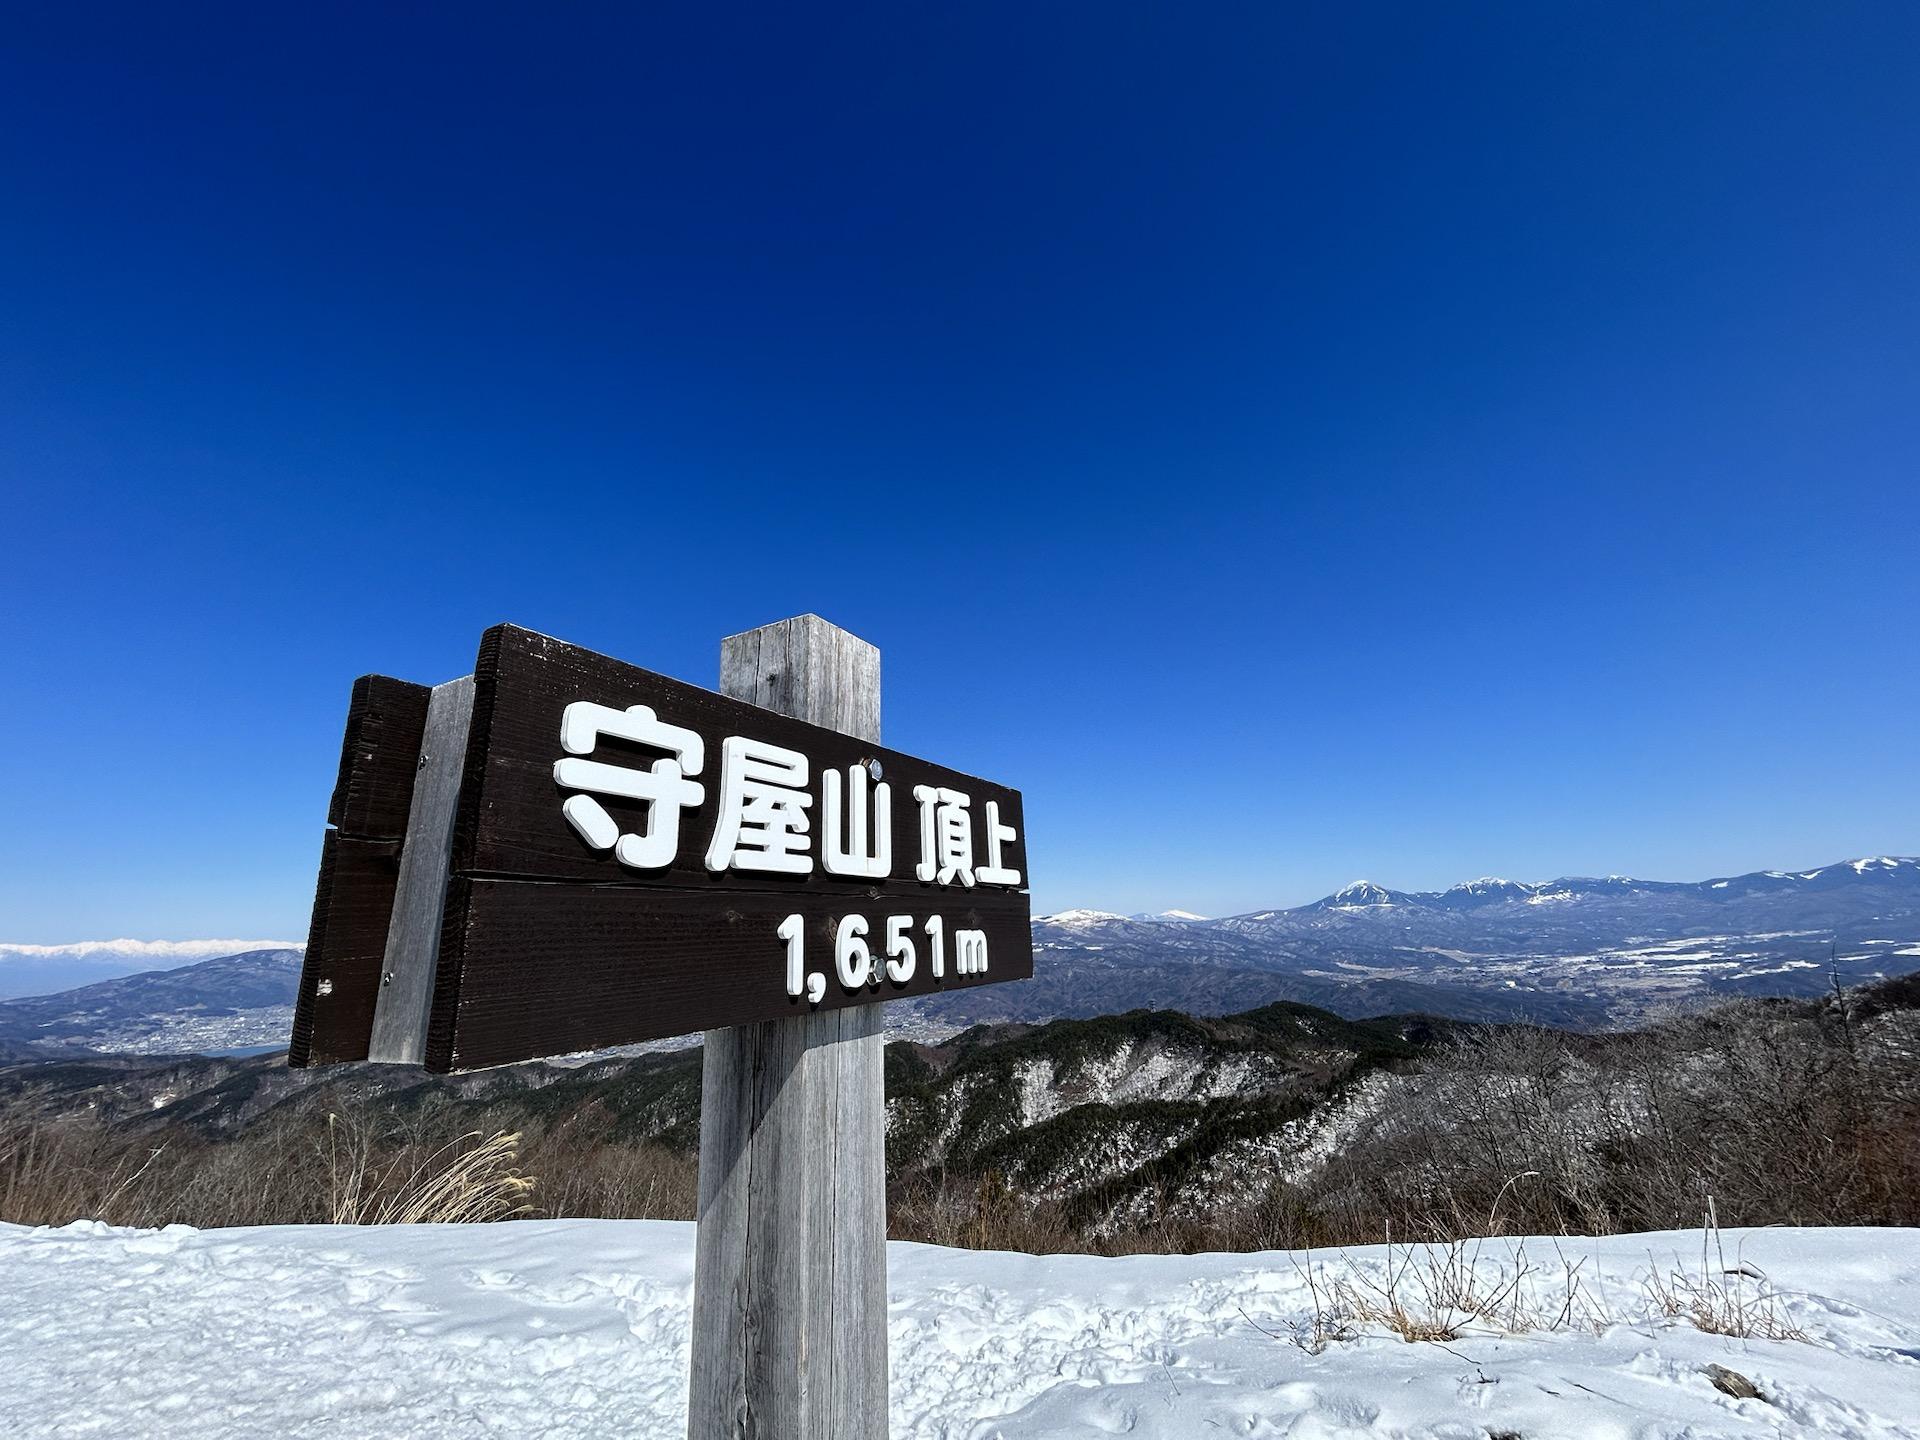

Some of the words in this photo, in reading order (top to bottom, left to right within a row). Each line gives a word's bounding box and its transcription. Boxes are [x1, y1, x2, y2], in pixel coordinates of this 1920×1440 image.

[553, 701, 892, 878] 守屋山
[913, 785, 1021, 887] 頂上
